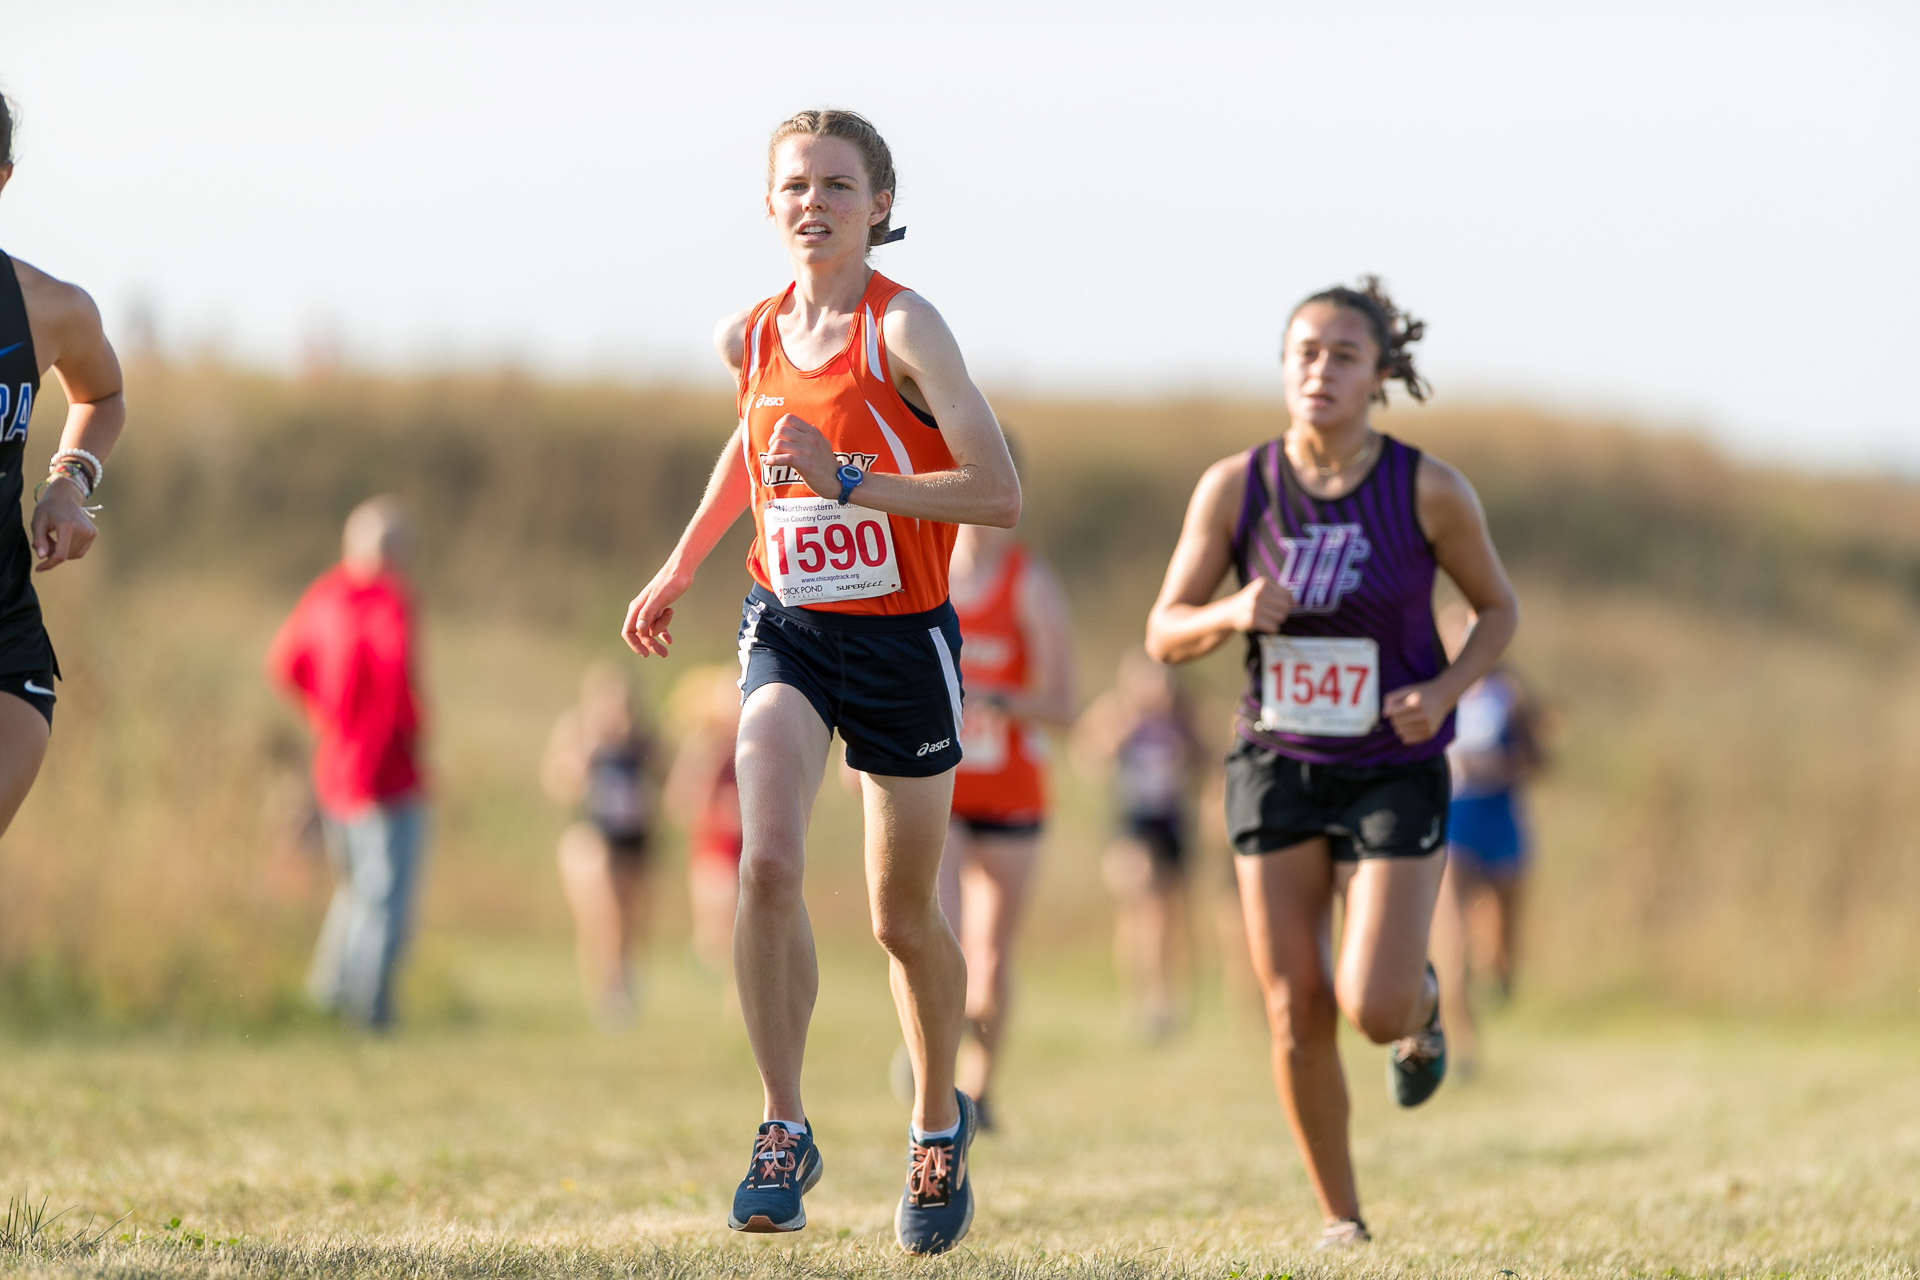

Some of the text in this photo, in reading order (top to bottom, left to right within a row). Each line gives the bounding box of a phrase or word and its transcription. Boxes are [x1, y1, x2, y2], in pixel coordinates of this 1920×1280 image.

[763, 396, 785, 407] asics
[782, 503, 833, 513] Northwestern
[773, 513, 841, 523] Cross Country Course
[771, 520, 887, 575] 1590
[801, 573, 860, 583] www.chicagotrack.org
[783, 587, 799, 596] DICK
[801, 585, 823, 594] POND
[1269, 661, 1371, 707] 1547
[928, 737, 950, 753] asics
